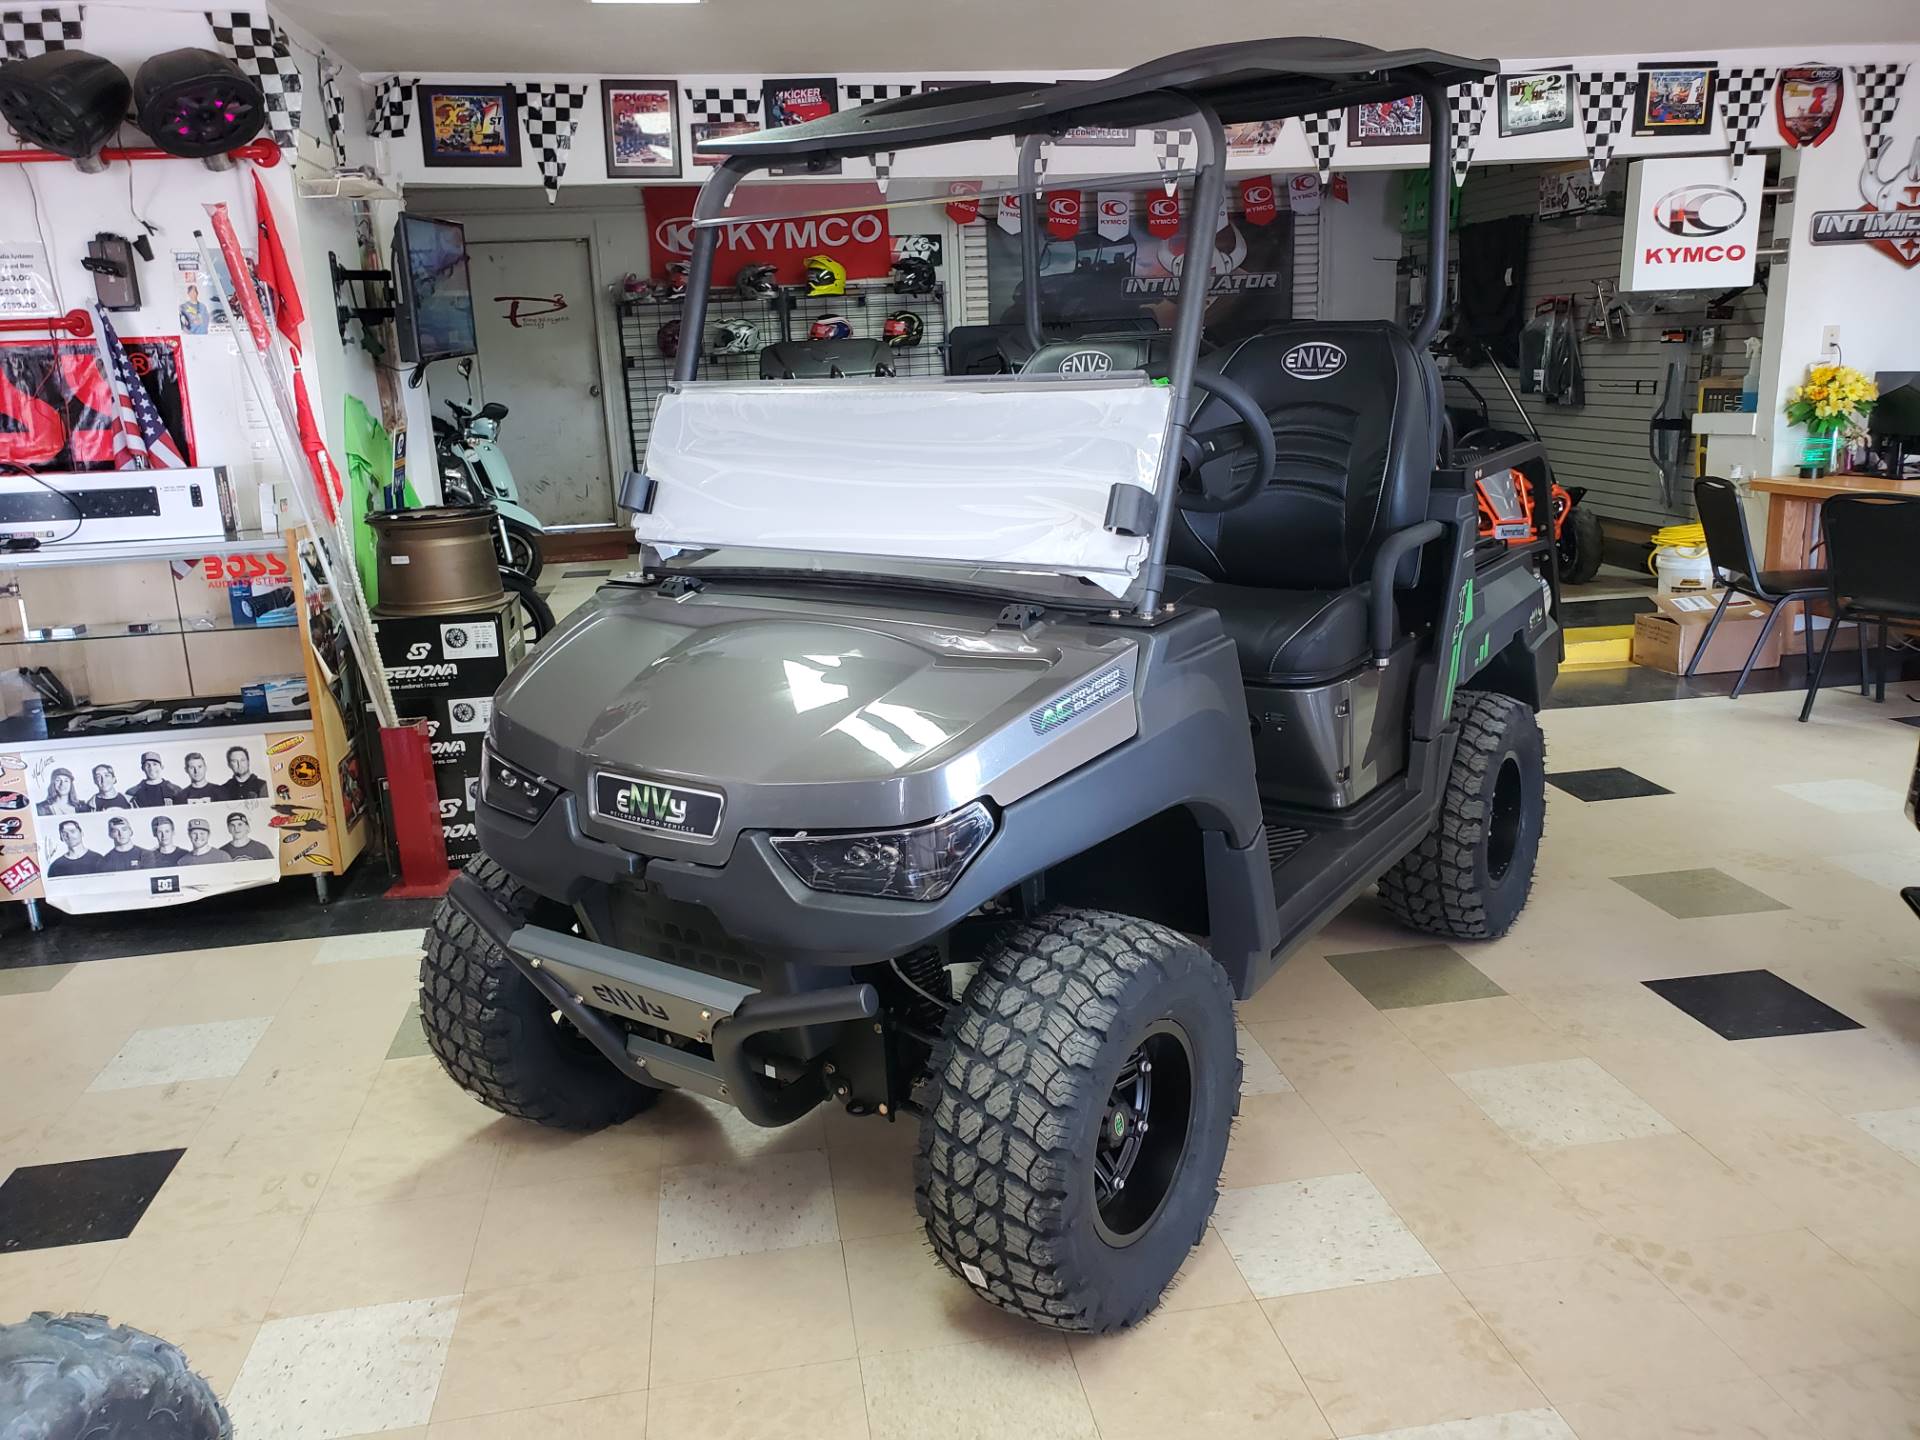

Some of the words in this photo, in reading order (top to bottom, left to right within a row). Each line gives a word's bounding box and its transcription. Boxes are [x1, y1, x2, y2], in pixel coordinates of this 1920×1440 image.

[784, 87, 821, 98] KICKER
[1386, 125, 1411, 133] PLACE
[1292, 192, 1318, 201] KYMCO
[1245, 204, 1274, 213] KYMCO
[1049, 217, 1078, 225] KYMCO
[727, 214, 882, 251] KYMCO
[1645, 244, 1746, 264] KYMCO
[203, 553, 287, 580] BOSS
[208, 580, 239, 589] AUDIO
[430, 740, 466, 754] ONA
[610, 810, 660, 826] NEIGHBORHOOD
[663, 823, 695, 833] VEHICLE
